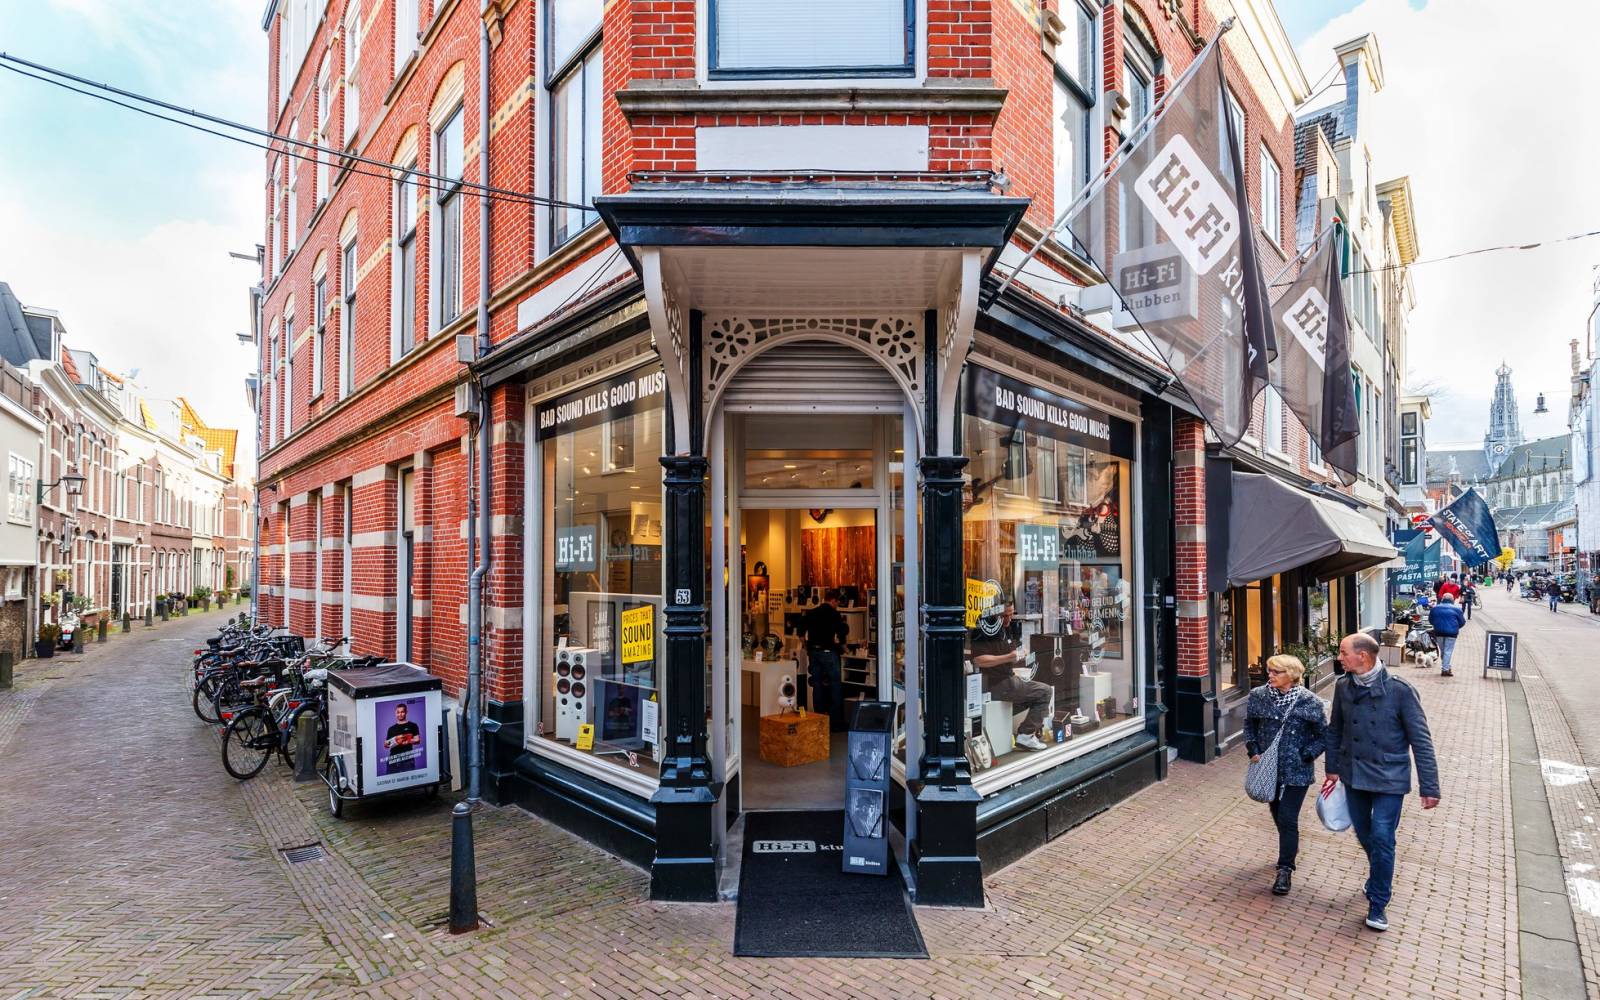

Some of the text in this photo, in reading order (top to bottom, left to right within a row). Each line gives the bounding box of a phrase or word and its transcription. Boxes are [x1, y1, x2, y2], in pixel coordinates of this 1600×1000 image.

[1148, 152, 1231, 259] Hi-Fi
[1125, 262, 1177, 290] Hi-Fi
[1120, 291, 1181, 312] klubben
[540, 371, 666, 430] BAD SOUND KILLS GOOD MUSI
[995, 386, 1110, 441] BAD SOUND KILLS GOOD MUSIC
[1443, 509, 1468, 532] STATE
[1468, 539, 1490, 558] ART
[558, 534, 593, 563] Hi-Fi
[1021, 533, 1057, 562] Hi-Fi
[1397, 572, 1422, 581] PASTA
[676, 590, 690, 604] 53
[623, 608, 652, 624] PRICES THAT
[623, 622, 651, 645] SOUND
[623, 643, 652, 658] AMAZING
[759, 842, 810, 851] Hi-Fi
